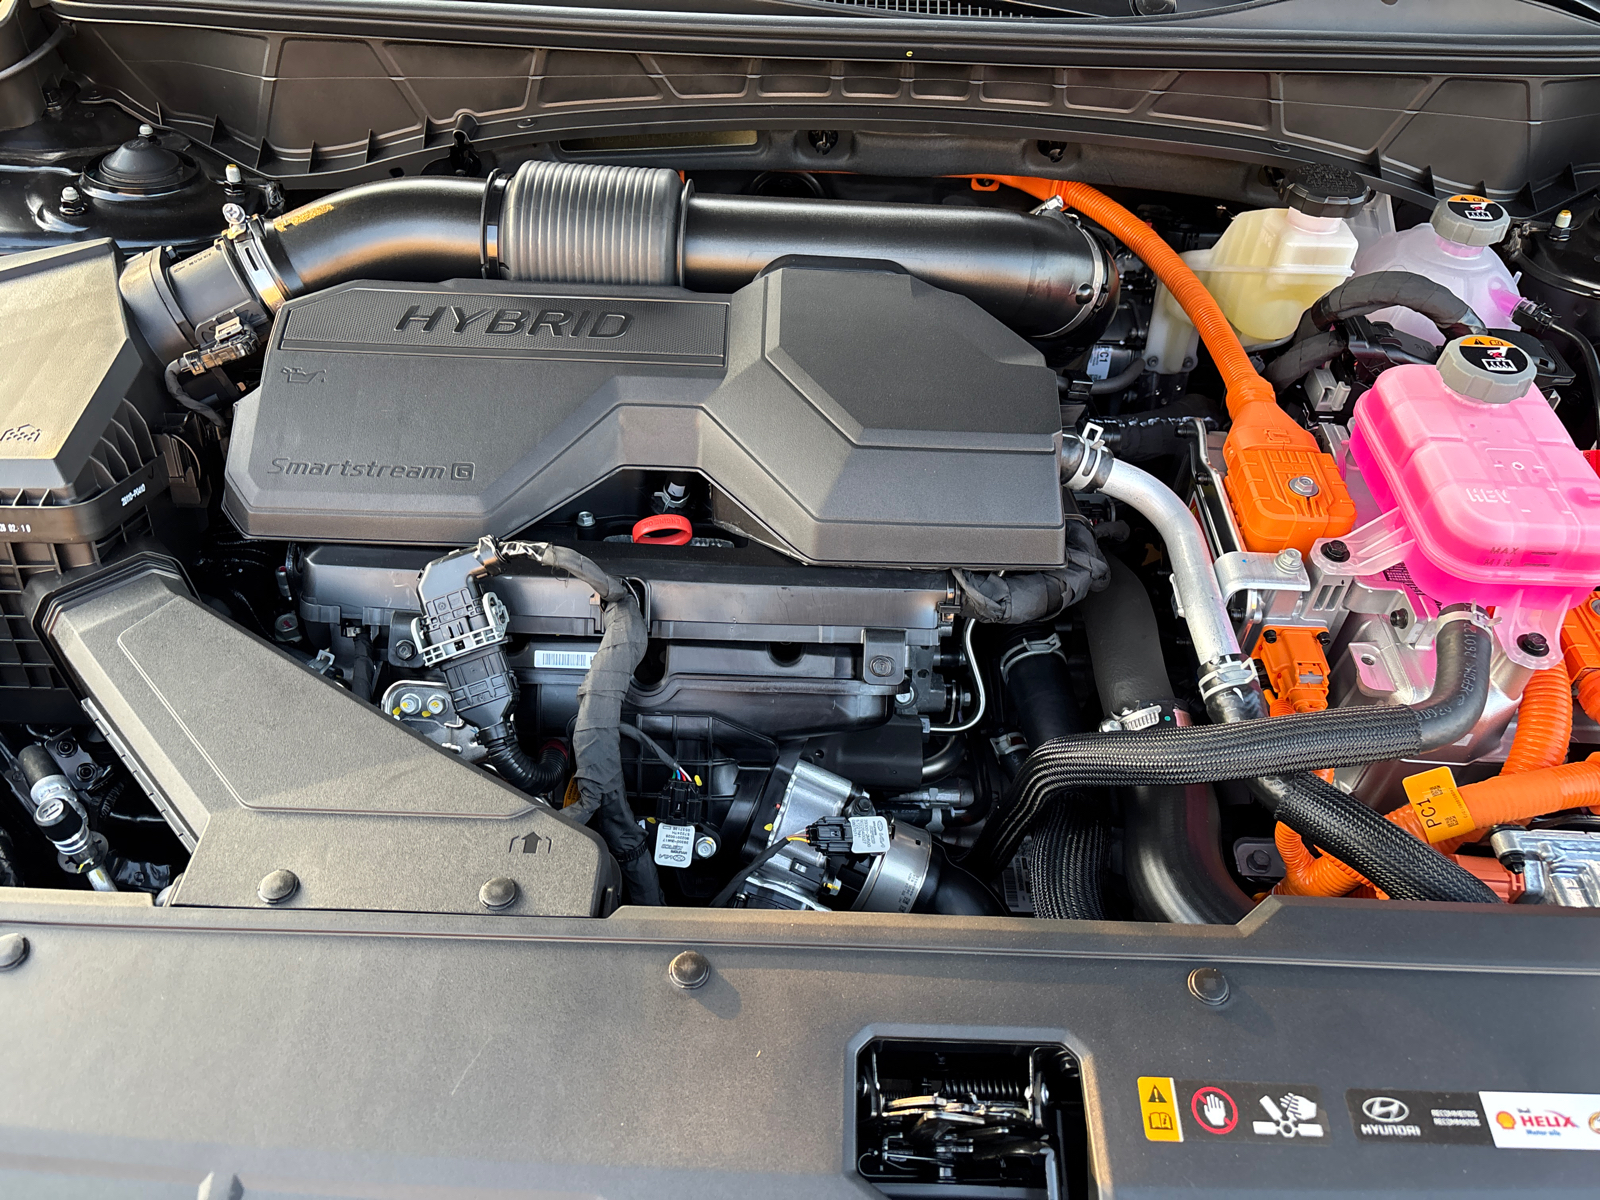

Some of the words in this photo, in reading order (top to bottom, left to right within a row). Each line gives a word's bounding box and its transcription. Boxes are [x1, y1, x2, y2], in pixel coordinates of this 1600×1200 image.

[394, 304, 634, 340] HYBRID
[267, 457, 446, 480] Smartstream
[1490, 546, 1519, 555] MAX
[1483, 558, 1513, 567] MIN
[1415, 797, 1444, 830] PC1
[1519, 1115, 1577, 1128] HELIX
[1361, 1124, 1422, 1137] HYUNDAI
